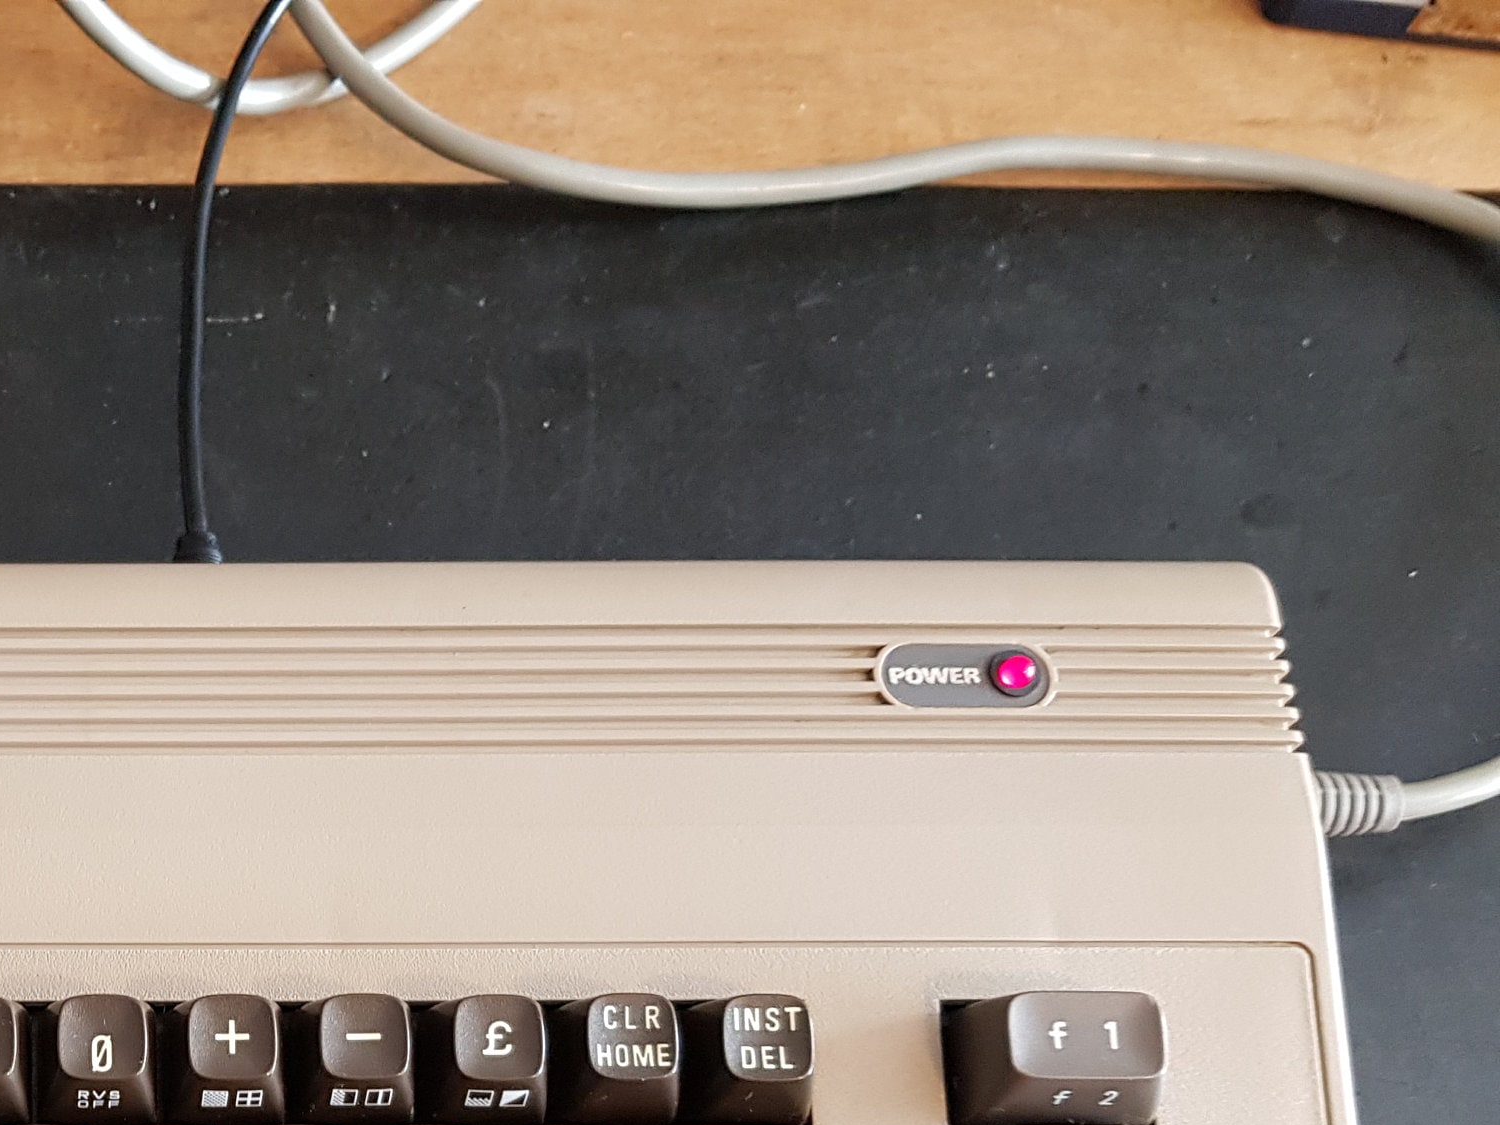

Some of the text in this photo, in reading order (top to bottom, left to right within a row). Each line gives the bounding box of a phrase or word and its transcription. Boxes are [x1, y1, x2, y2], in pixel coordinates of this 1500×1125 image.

[888, 667, 981, 685] POWER
[602, 1004, 661, 1030] CLR
[733, 1006, 802, 1033] INST
[214, 1019, 250, 1055] +
[482, 1020, 513, 1056] £
[1048, 1021, 1119, 1050] f 1
[596, 1042, 671, 1068] HOME
[740, 1045, 794, 1070] DEL
[77, 1089, 120, 1100] RVS
[77, 1100, 120, 1109] OFF
[1053, 1090, 1119, 1106] f 2
